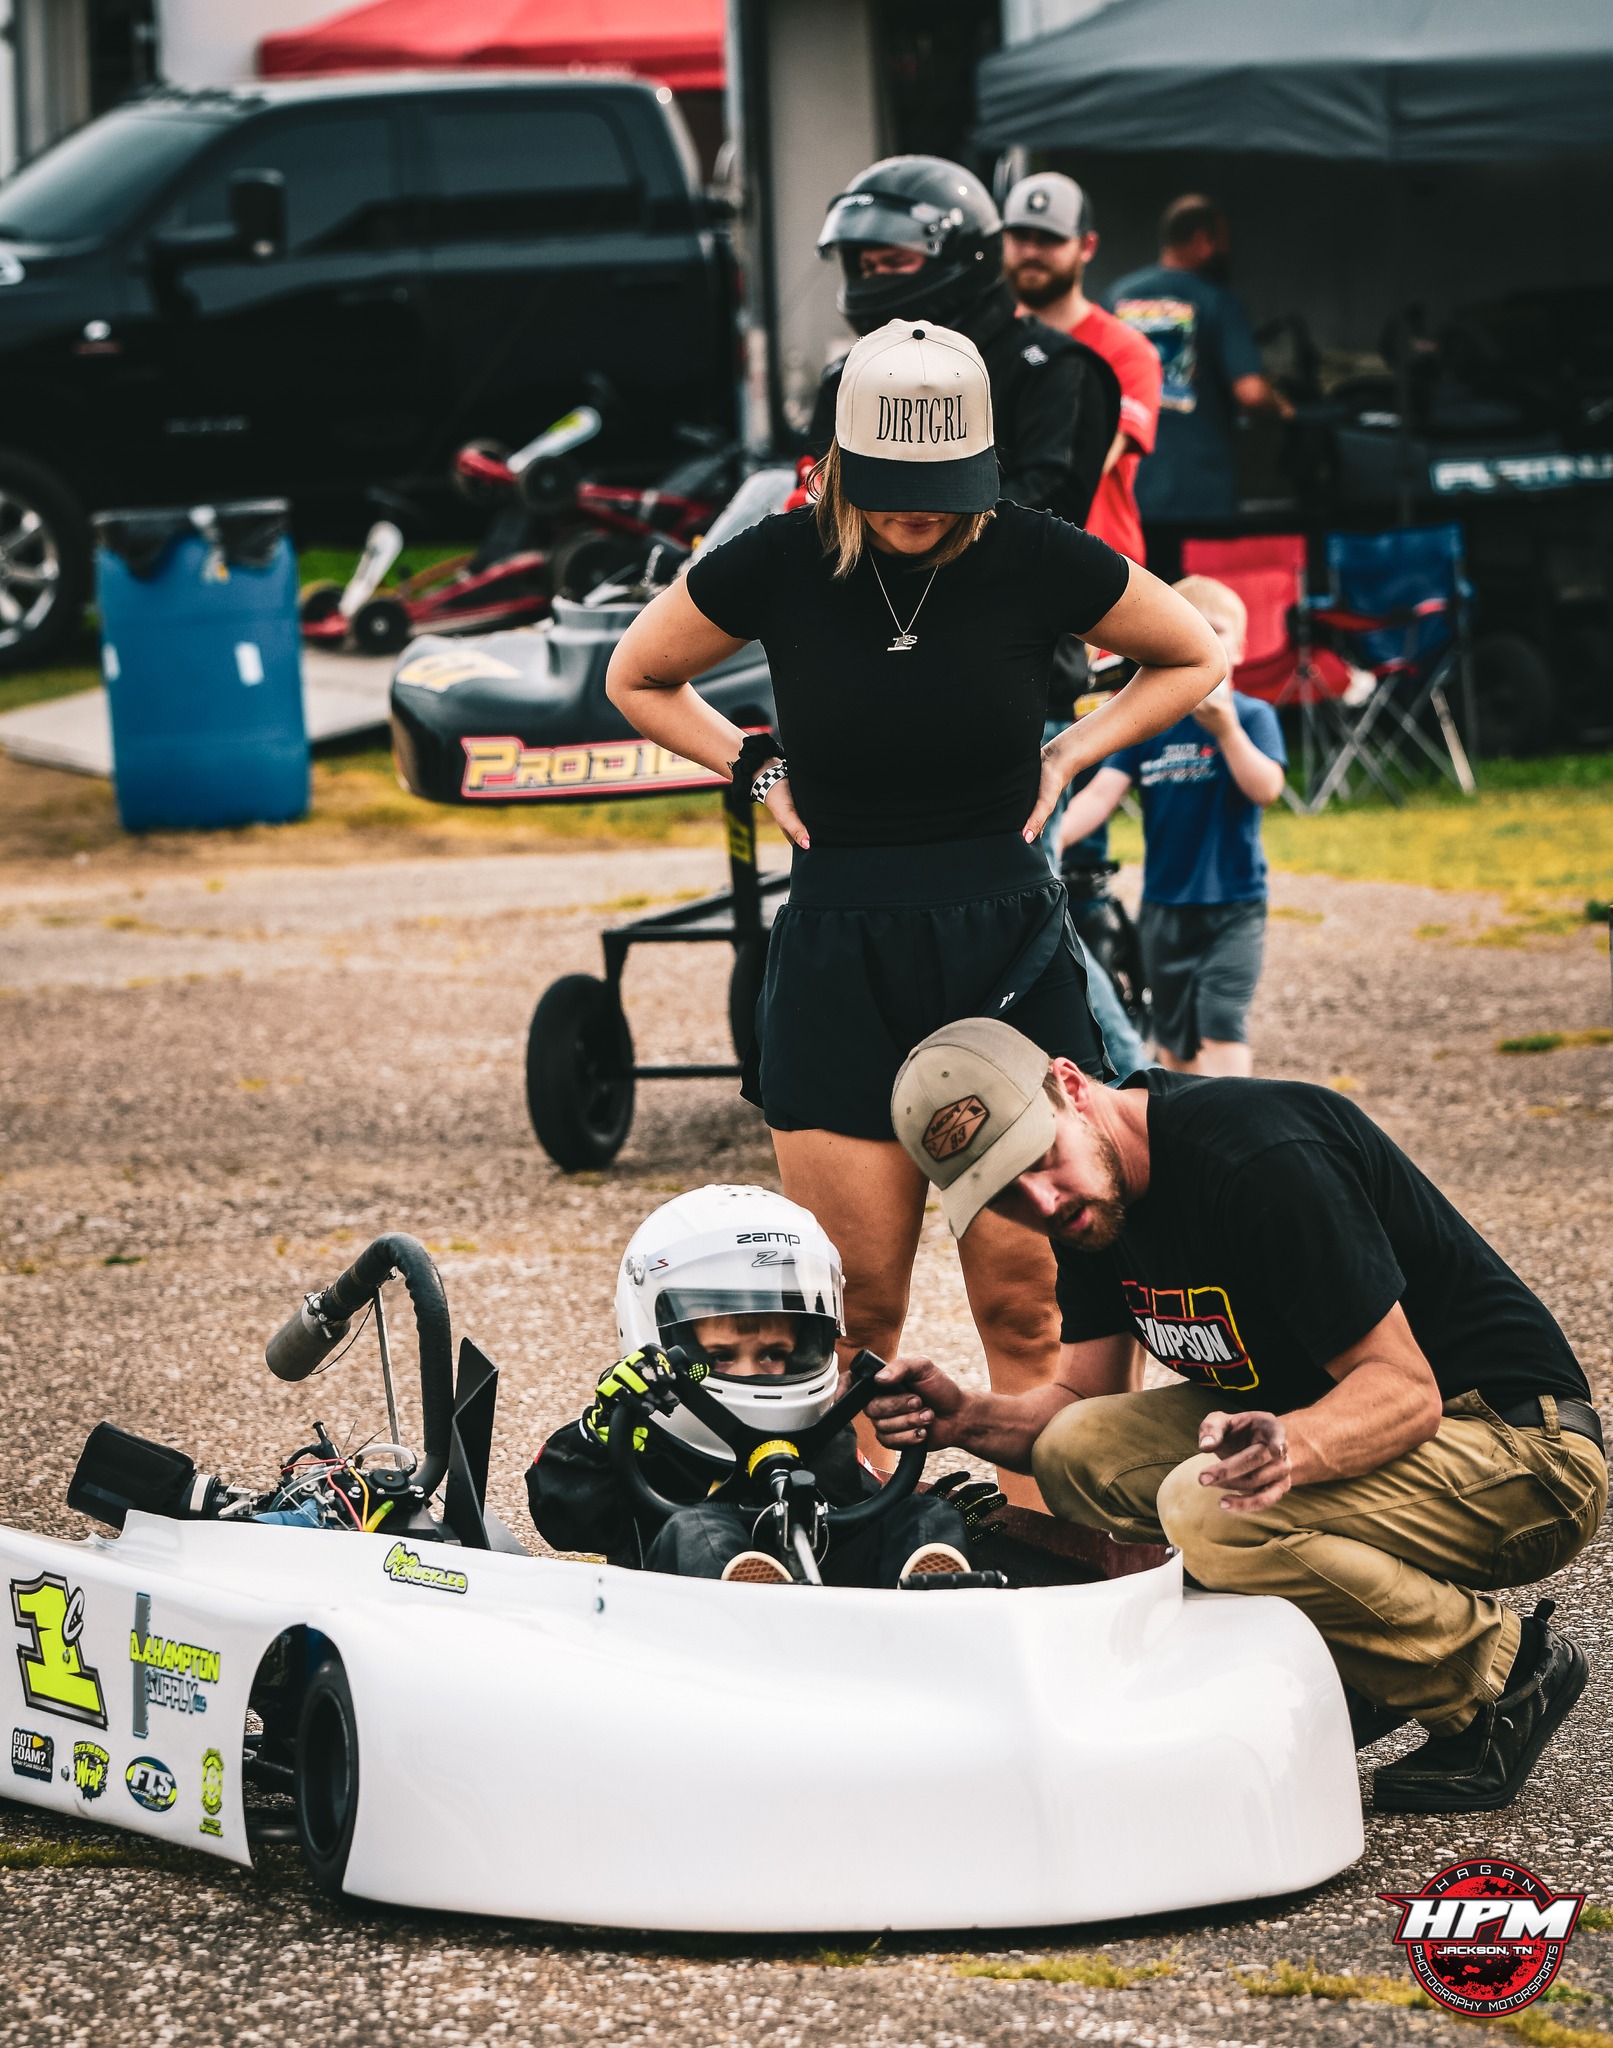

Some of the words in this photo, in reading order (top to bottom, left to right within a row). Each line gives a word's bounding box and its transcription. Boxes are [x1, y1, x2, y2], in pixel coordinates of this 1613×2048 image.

[876, 394, 967, 443] DIRTGRL
[736, 1231, 801, 1247] zamp
[146, 1668, 198, 1714] SUPPLY
[13, 1731, 34, 1750] GOT
[12, 1745, 47, 1765] FOAM?
[131, 1763, 173, 1797] FTS
